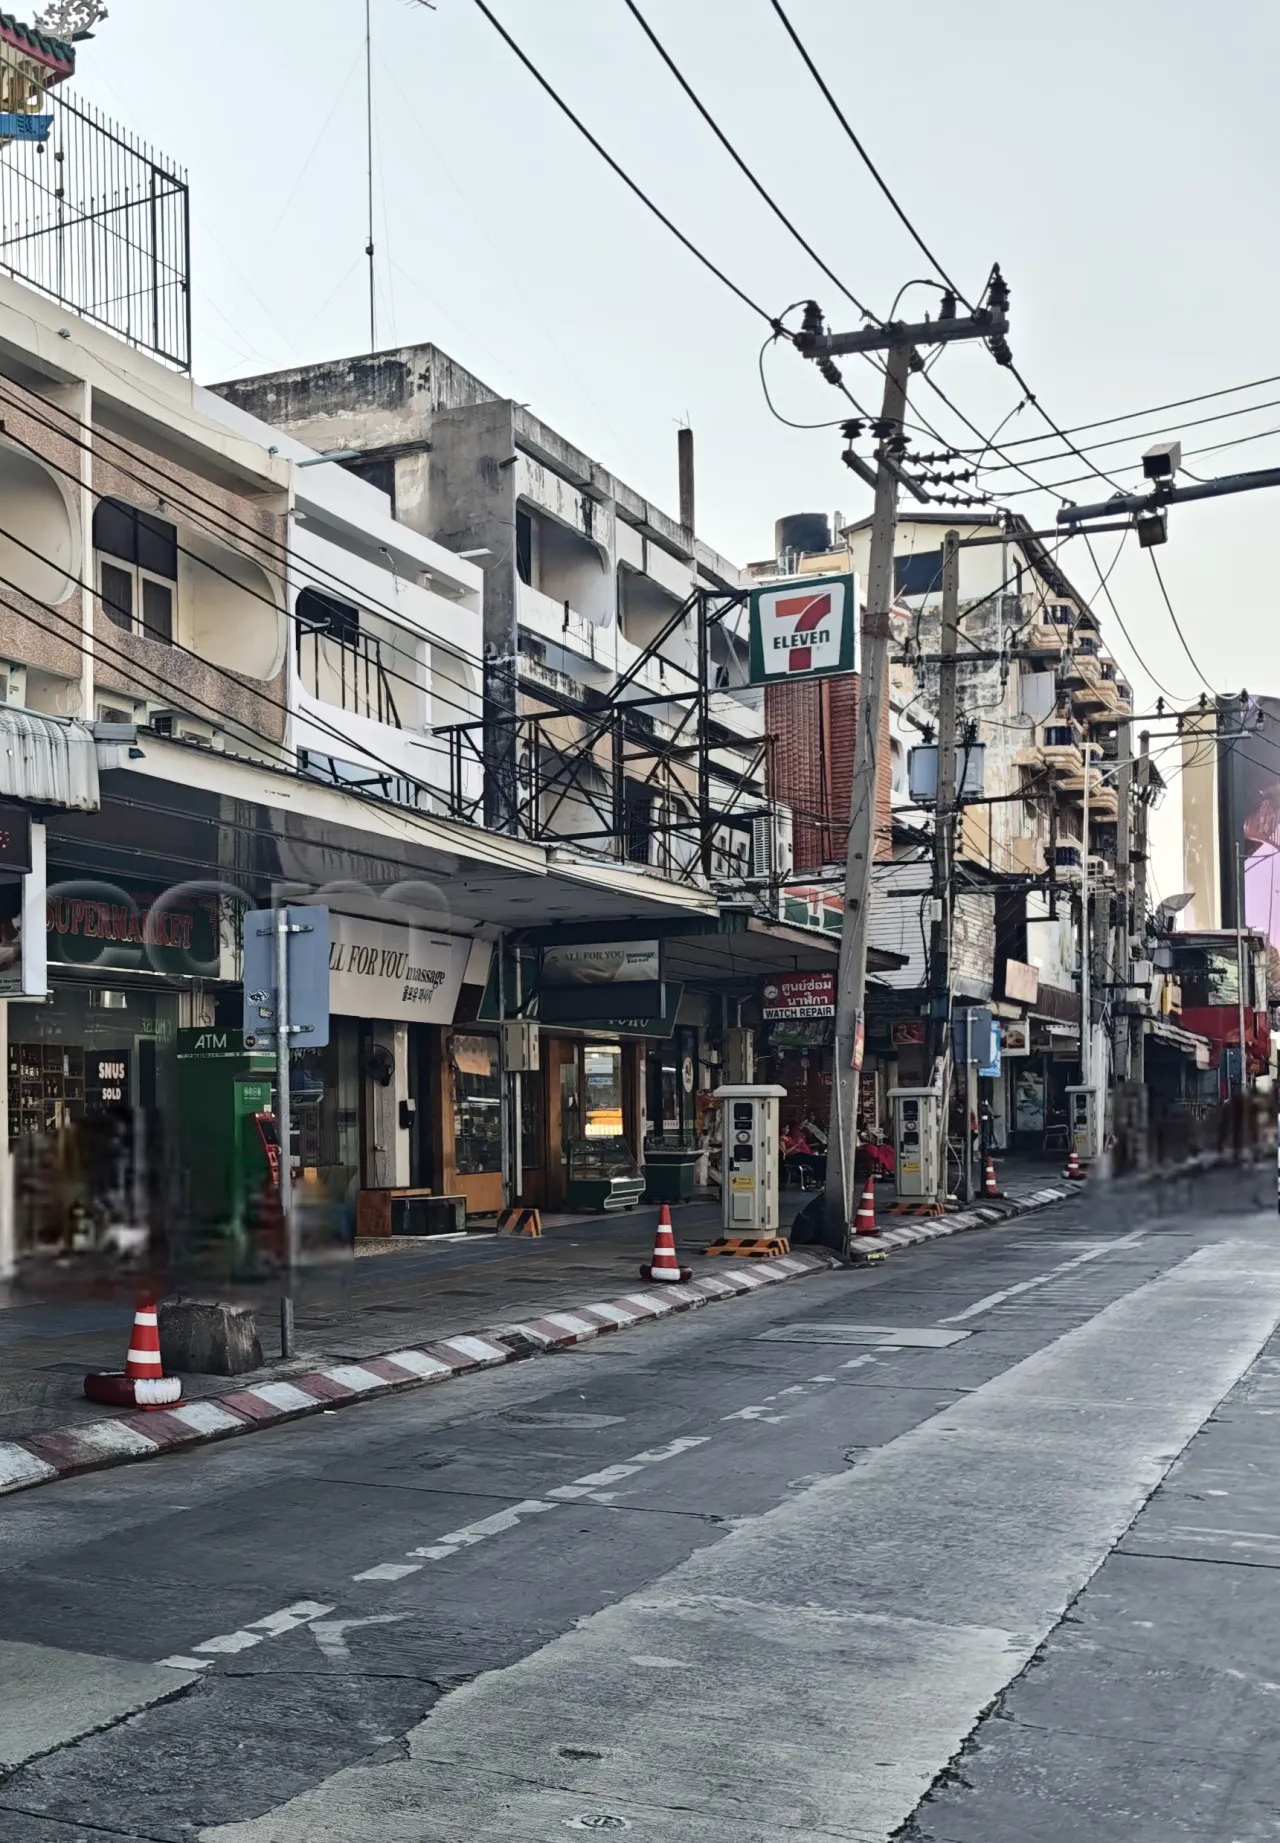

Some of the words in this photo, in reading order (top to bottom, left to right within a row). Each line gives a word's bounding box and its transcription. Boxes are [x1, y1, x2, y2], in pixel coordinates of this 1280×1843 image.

[775, 592, 832, 672] 7
[46, 895, 194, 950] SUPERMARKET
[563, 952, 581, 961] ALL
[583, 951, 603, 960] FOR
[604, 950, 625, 960] YOU
[329, 942, 347, 971] LL
[347, 945, 379, 976] FOR
[379, 949, 409, 979] YOU
[405, 966, 446, 990] massage
[781, 979, 832, 997] ศูนย์ซ่อม
[787, 991, 829, 1006] นาฬิกา
[765, 1008, 797, 1019] WATCH
[799, 1006, 832, 1017] REPAIR
[194, 1033, 227, 1049] ATM
[98, 1062, 126, 1080] SNUS
[102, 1088, 122, 1101] SOLD
